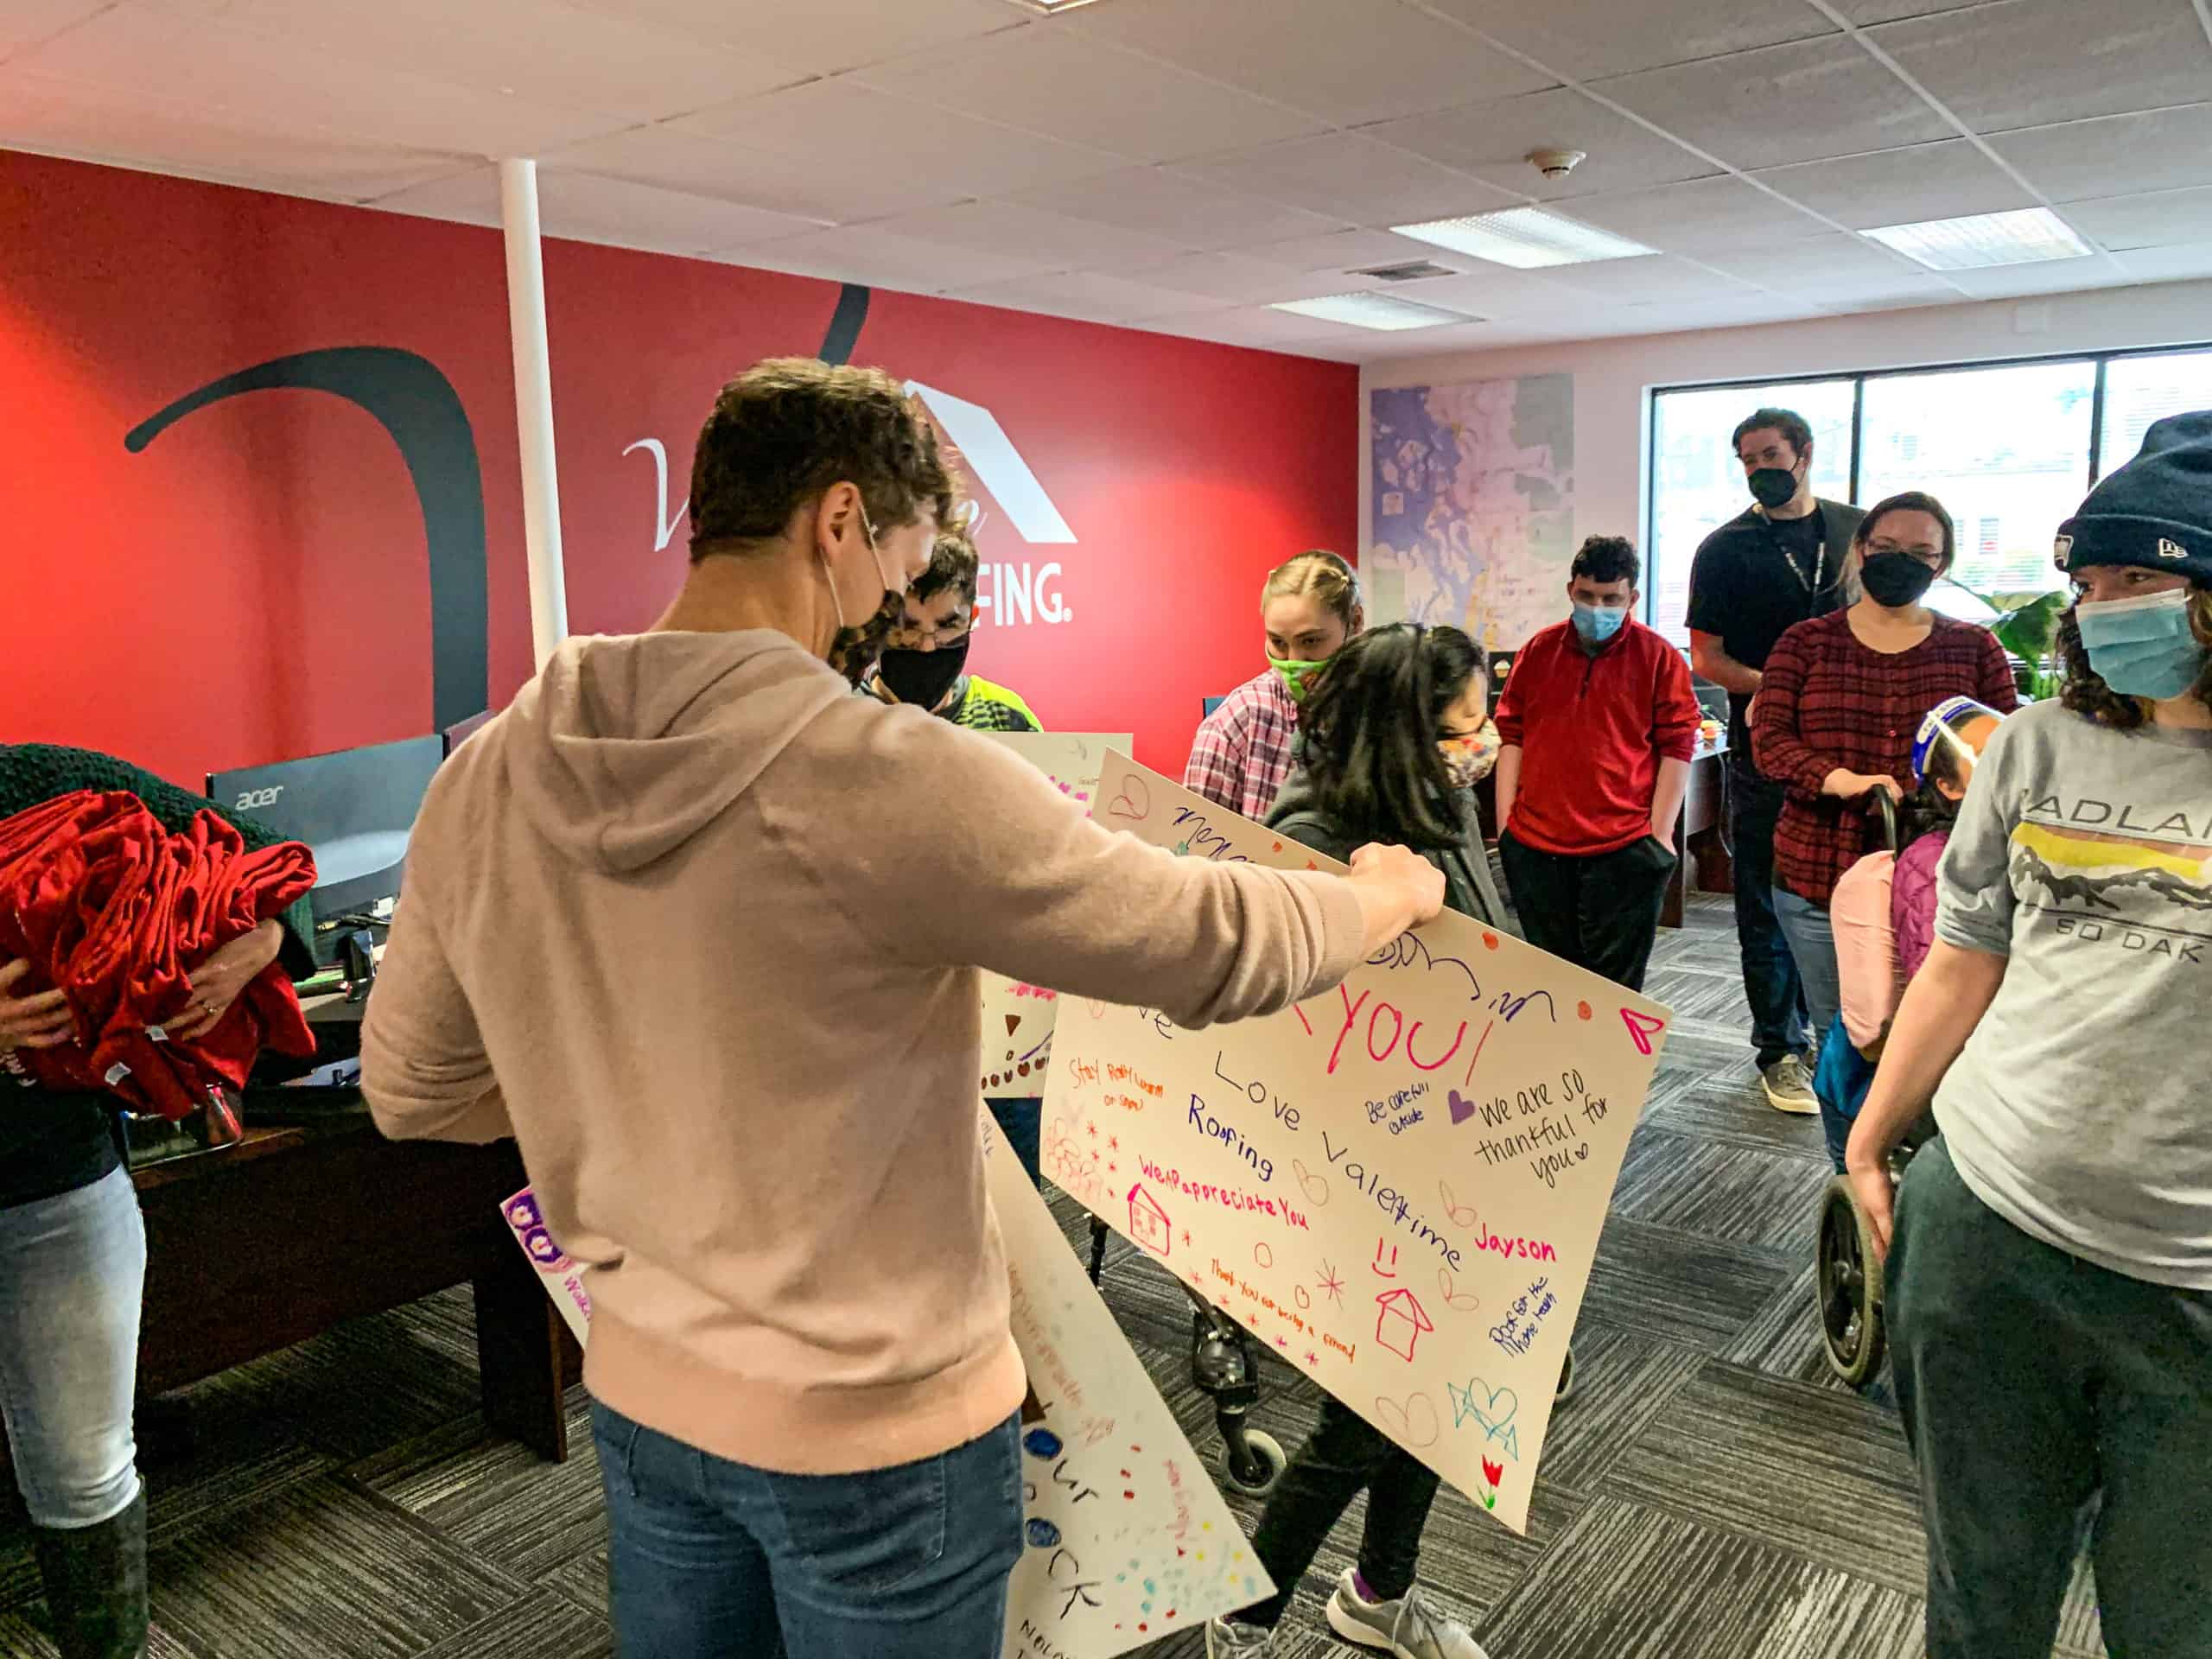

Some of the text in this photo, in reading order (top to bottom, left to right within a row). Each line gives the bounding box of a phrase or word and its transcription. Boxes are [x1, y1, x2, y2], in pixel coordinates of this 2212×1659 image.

[235, 785, 283, 810] acer
[2024, 795, 2212, 839] ADLA
[2056, 918, 2204, 963] SO DAK
[1214, 1050, 1300, 1131] Love
[1516, 1083, 1554, 1116] are
[1364, 1100, 1388, 1124] Be
[1474, 1093, 1607, 1166] thankful for
[1530, 1147, 1575, 1189] you
[1474, 1222, 1557, 1262] Jayson
